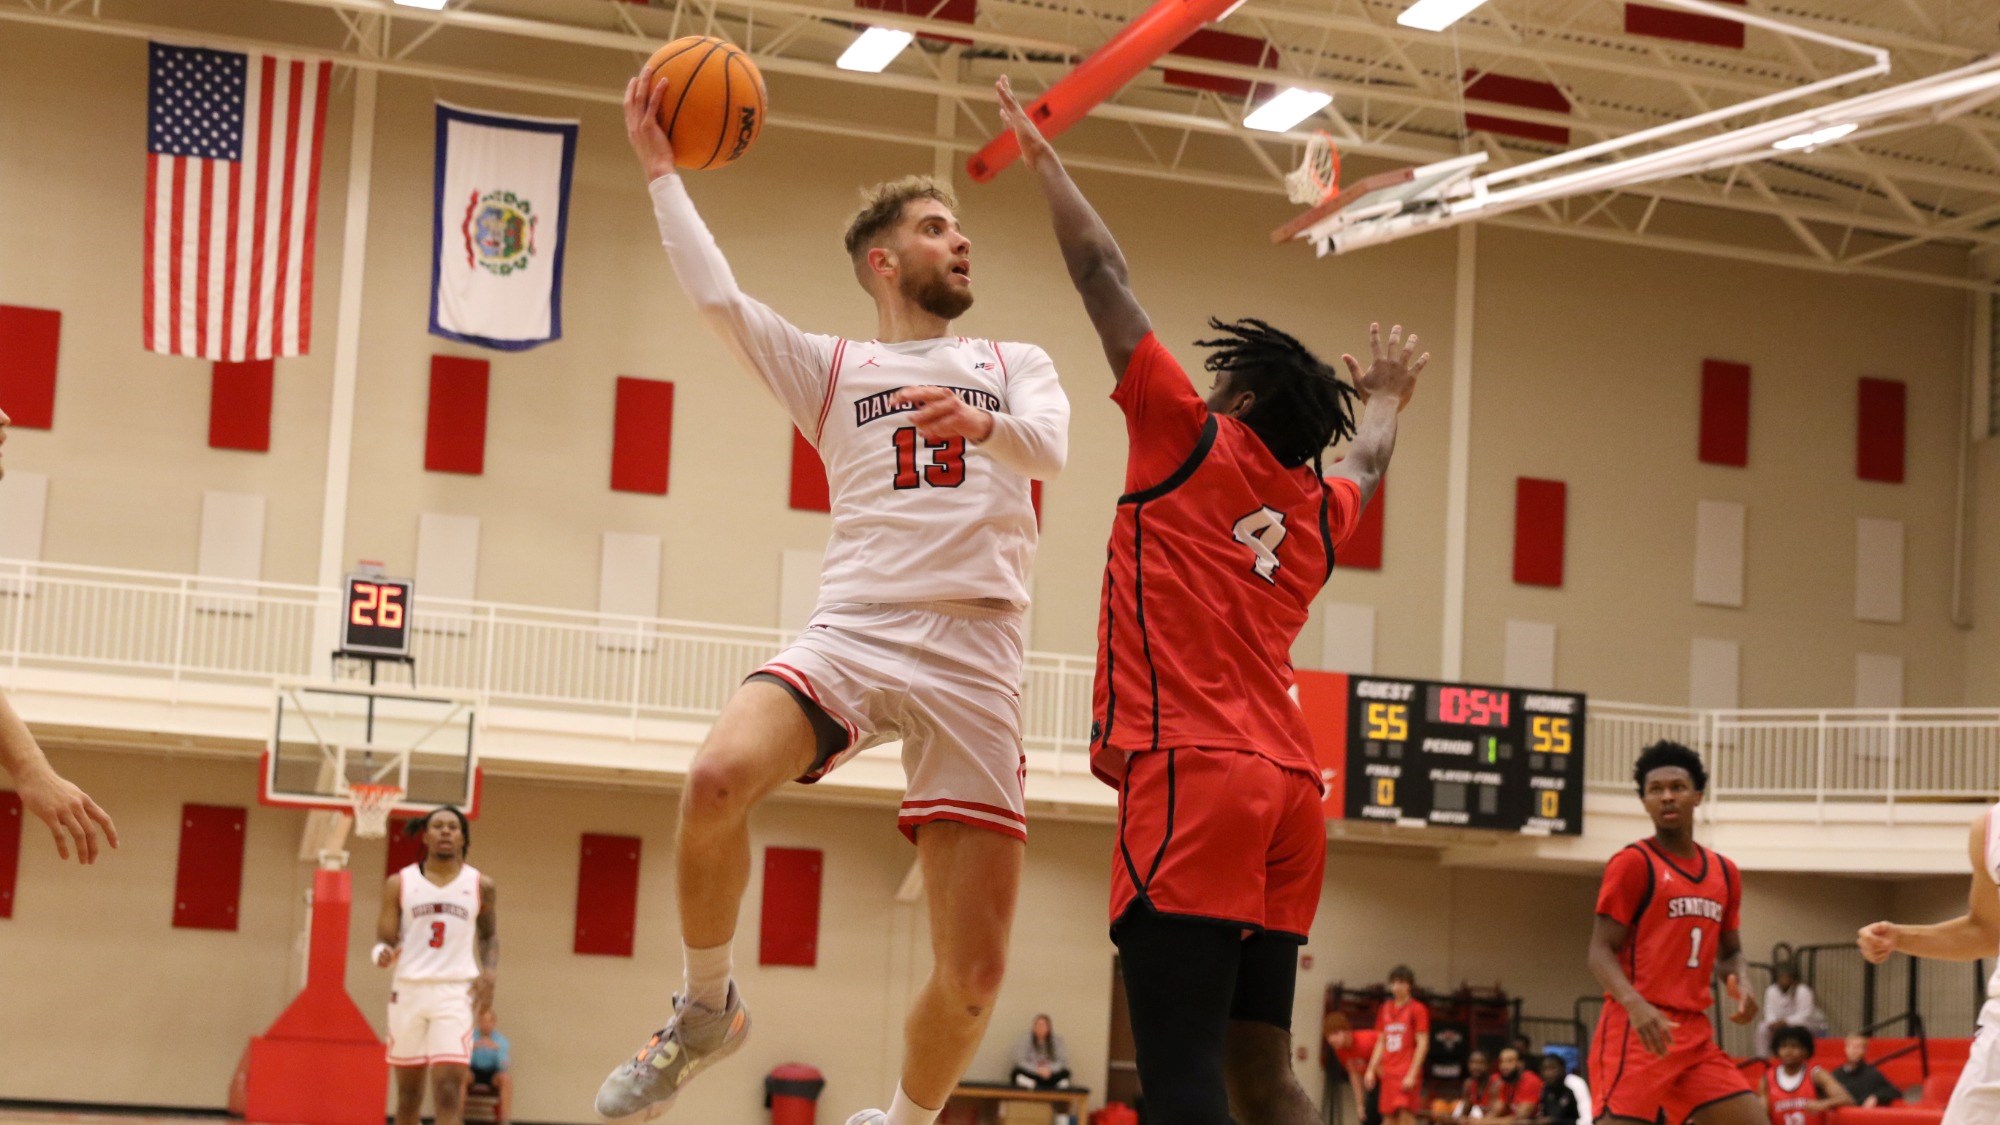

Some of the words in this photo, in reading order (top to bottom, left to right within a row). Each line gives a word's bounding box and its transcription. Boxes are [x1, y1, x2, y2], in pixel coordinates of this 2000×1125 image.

[727, 107, 756, 161] NCAA
[953, 388, 999, 412] KINS
[892, 426, 966, 490] 13
[1232, 504, 1287, 585] 4
[351, 583, 403, 629] 26
[1356, 680, 1415, 701] GUEST
[1368, 702, 1408, 742] 55
[1532, 715, 1572, 754] 55
[1423, 737, 1474, 755] PERIOD
[1487, 736, 1497, 764] 1
[1377, 778, 1395, 806] 0
[1541, 790, 1559, 818] 0
[429, 921, 446, 949] 3
[1686, 926, 1702, 969] 1
